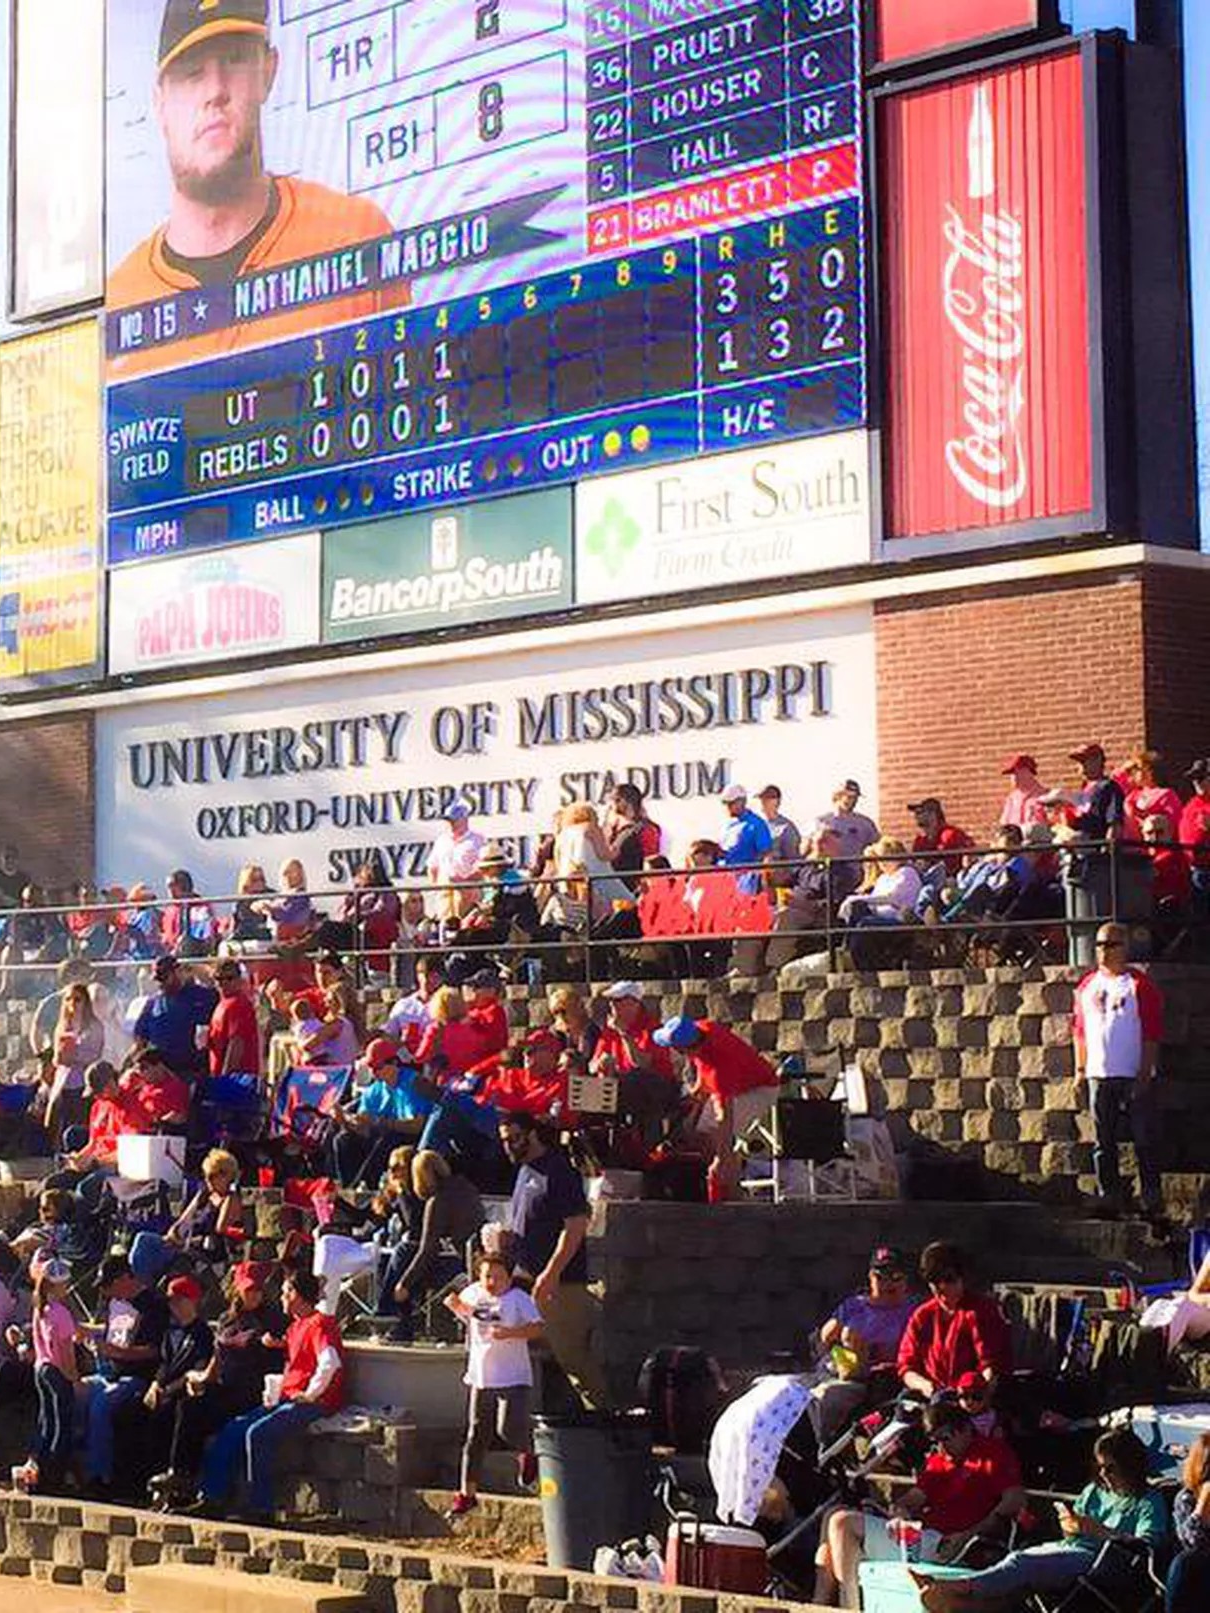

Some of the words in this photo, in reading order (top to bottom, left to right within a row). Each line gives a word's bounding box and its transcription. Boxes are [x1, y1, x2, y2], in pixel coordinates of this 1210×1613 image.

[331, 36, 373, 80] HR
[591, 12, 621, 38] 15
[592, 57, 622, 88] 36
[653, 15, 757, 71] PRUETT
[801, 51, 820, 80] C
[477, 81, 504, 142] 8
[593, 110, 623, 141] 22
[652, 68, 761, 124] HOUSER
[803, 101, 836, 134] RF
[365, 119, 417, 168] RBI
[601, 165, 615, 192] 5
[671, 132, 738, 172] HALL
[812, 160, 830, 188] P
[593, 217, 623, 247] 21
[636, 172, 777, 232] BRAMLETT
[152, 302, 177, 338] 15
[234, 252, 369, 318] NATHANIEL
[380, 214, 489, 280] MAGGIO
[313, 338, 325, 362] 1
[355, 328, 368, 352] 2
[393, 318, 406, 343] 3
[435, 308, 449, 330] 4
[478, 297, 491, 321] 5
[523, 285, 538, 309] 6
[569, 273, 583, 298] 7
[615, 261, 631, 286] 8
[662, 249, 678, 274] 9
[717, 235, 734, 261] R
[769, 222, 786, 249] H
[824, 208, 840, 235] E
[225, 391, 258, 427] UT
[311, 371, 328, 409] 1
[350, 361, 370, 398] 0
[393, 352, 411, 391] 1
[434, 342, 452, 381] 1
[716, 272, 738, 315] 3
[767, 258, 790, 303] 5
[820, 247, 846, 290] 0
[199, 435, 290, 482] REBELS
[310, 421, 331, 459] 0
[350, 412, 370, 451] 0
[392, 403, 411, 442] 0
[434, 394, 453, 434] 1
[716, 331, 739, 373] 1
[767, 317, 791, 361] 3
[820, 305, 845, 351] 2
[108, 417, 181, 456] SWAYZE
[122, 449, 169, 483] FIELD
[135, 520, 178, 551] MPH
[255, 495, 305, 529] BALL
[393, 460, 473, 501] STRIKE
[541, 437, 592, 470] OUT
[721, 398, 777, 438] H/E
[655, 477, 735, 534] First
[752, 459, 862, 520] South
[330, 547, 562, 620] BancorpSouth
[135, 592, 197, 657] PAPA
[127, 710, 411, 791] UNIVERSITY
[431, 700, 498, 757] OF
[517, 659, 832, 749] MISSISSIPPI
[198, 777, 539, 839] OXFORD-UNIVERSITY
[559, 757, 732, 807] STADIUM
[327, 840, 435, 884] SWAYZ
